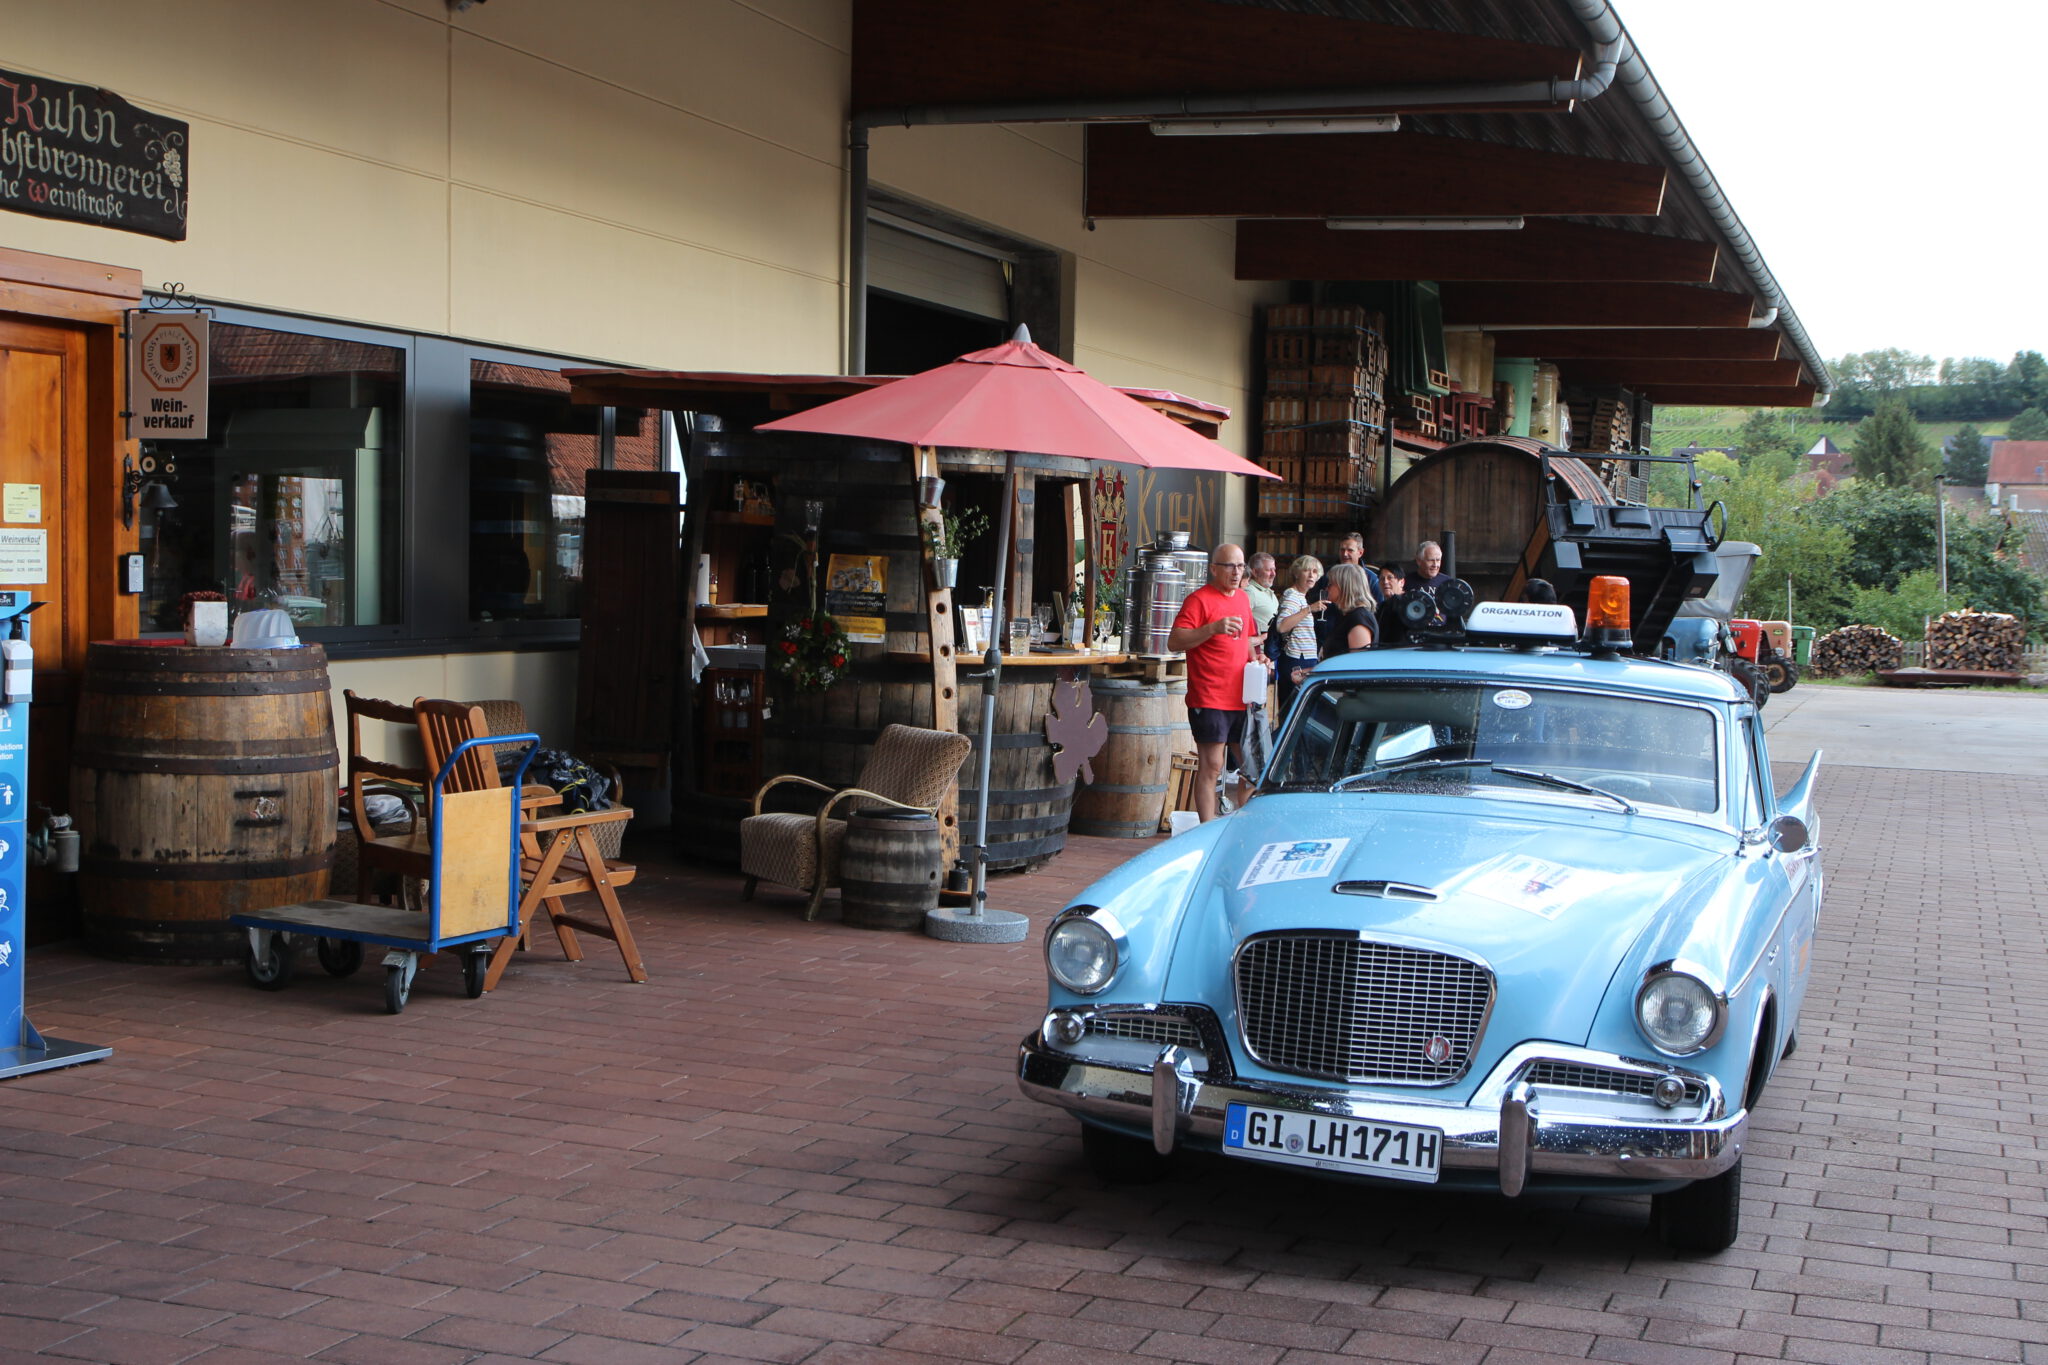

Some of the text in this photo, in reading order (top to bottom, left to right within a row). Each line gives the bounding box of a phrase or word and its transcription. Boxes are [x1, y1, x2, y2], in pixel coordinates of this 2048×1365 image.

[0, 77, 123, 148] Kuhn
[28, 178, 123, 218] Weinstraße
[151, 398, 188, 412] Wein-
[143, 414, 194, 429] verkauf
[1, 535, 41, 545] Weinverkauf
[1481, 607, 1563, 618] ORGANISATION
[1231, 1129, 1239, 1140] D
[1248, 1111, 1437, 1169] GI LH171H
